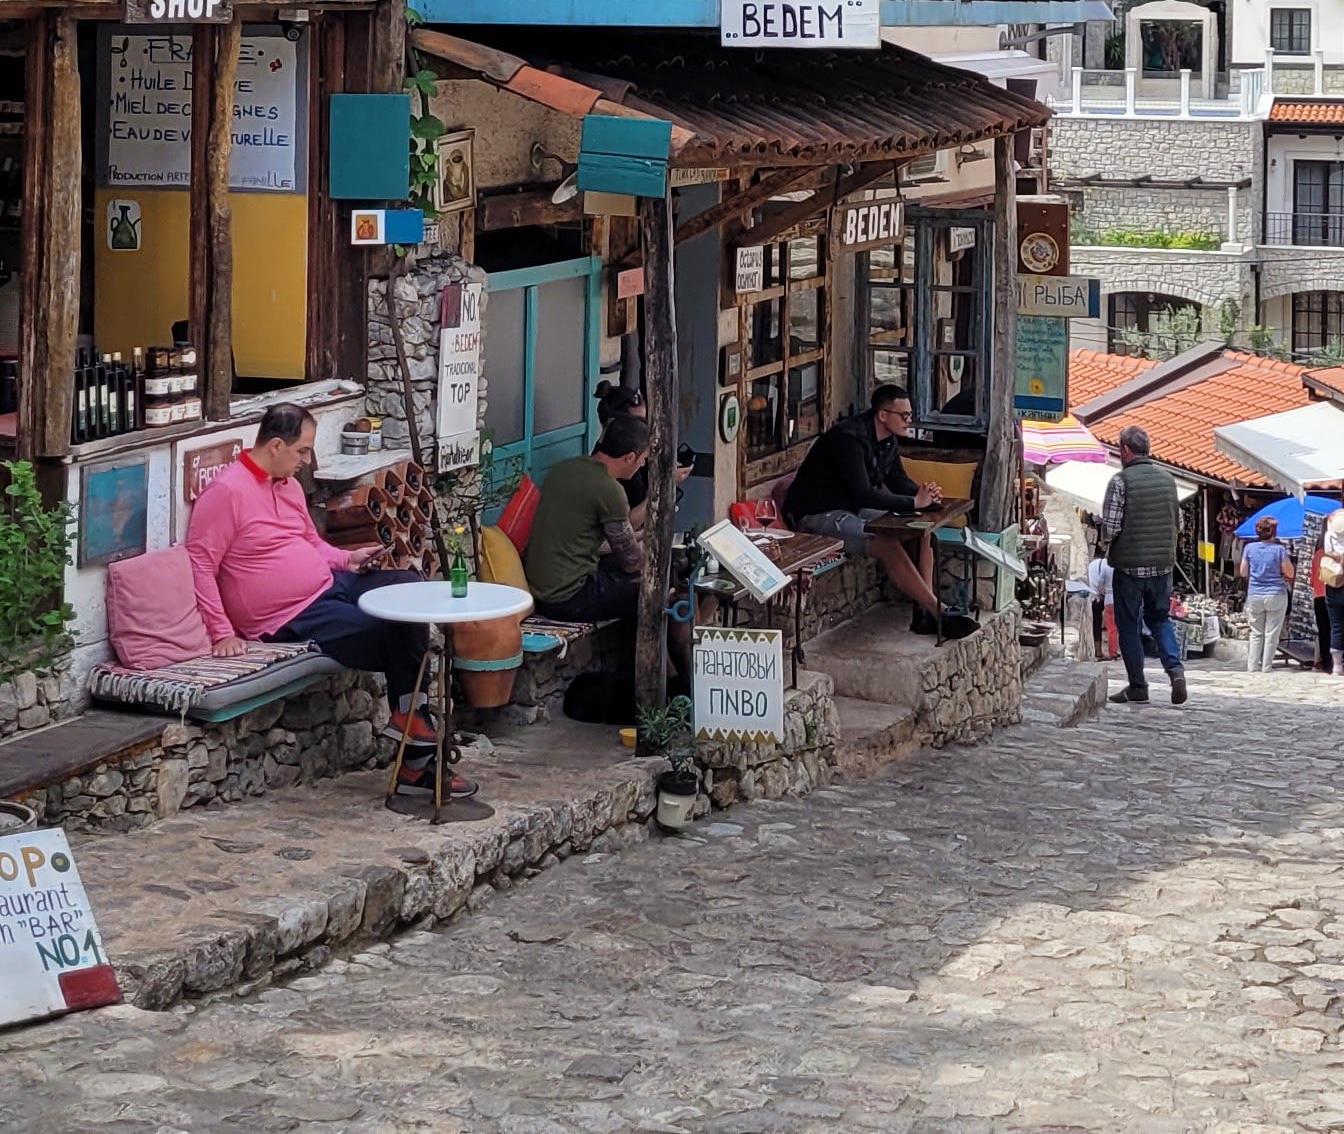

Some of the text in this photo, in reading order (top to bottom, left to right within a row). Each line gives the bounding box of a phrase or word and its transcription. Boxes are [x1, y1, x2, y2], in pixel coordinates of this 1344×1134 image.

[130, 68, 177, 91] HUILE
[115, 91, 153, 115] MIEL
[1034, 285, 1086, 307] РЫБА
[451, 382, 471, 403] TOP
